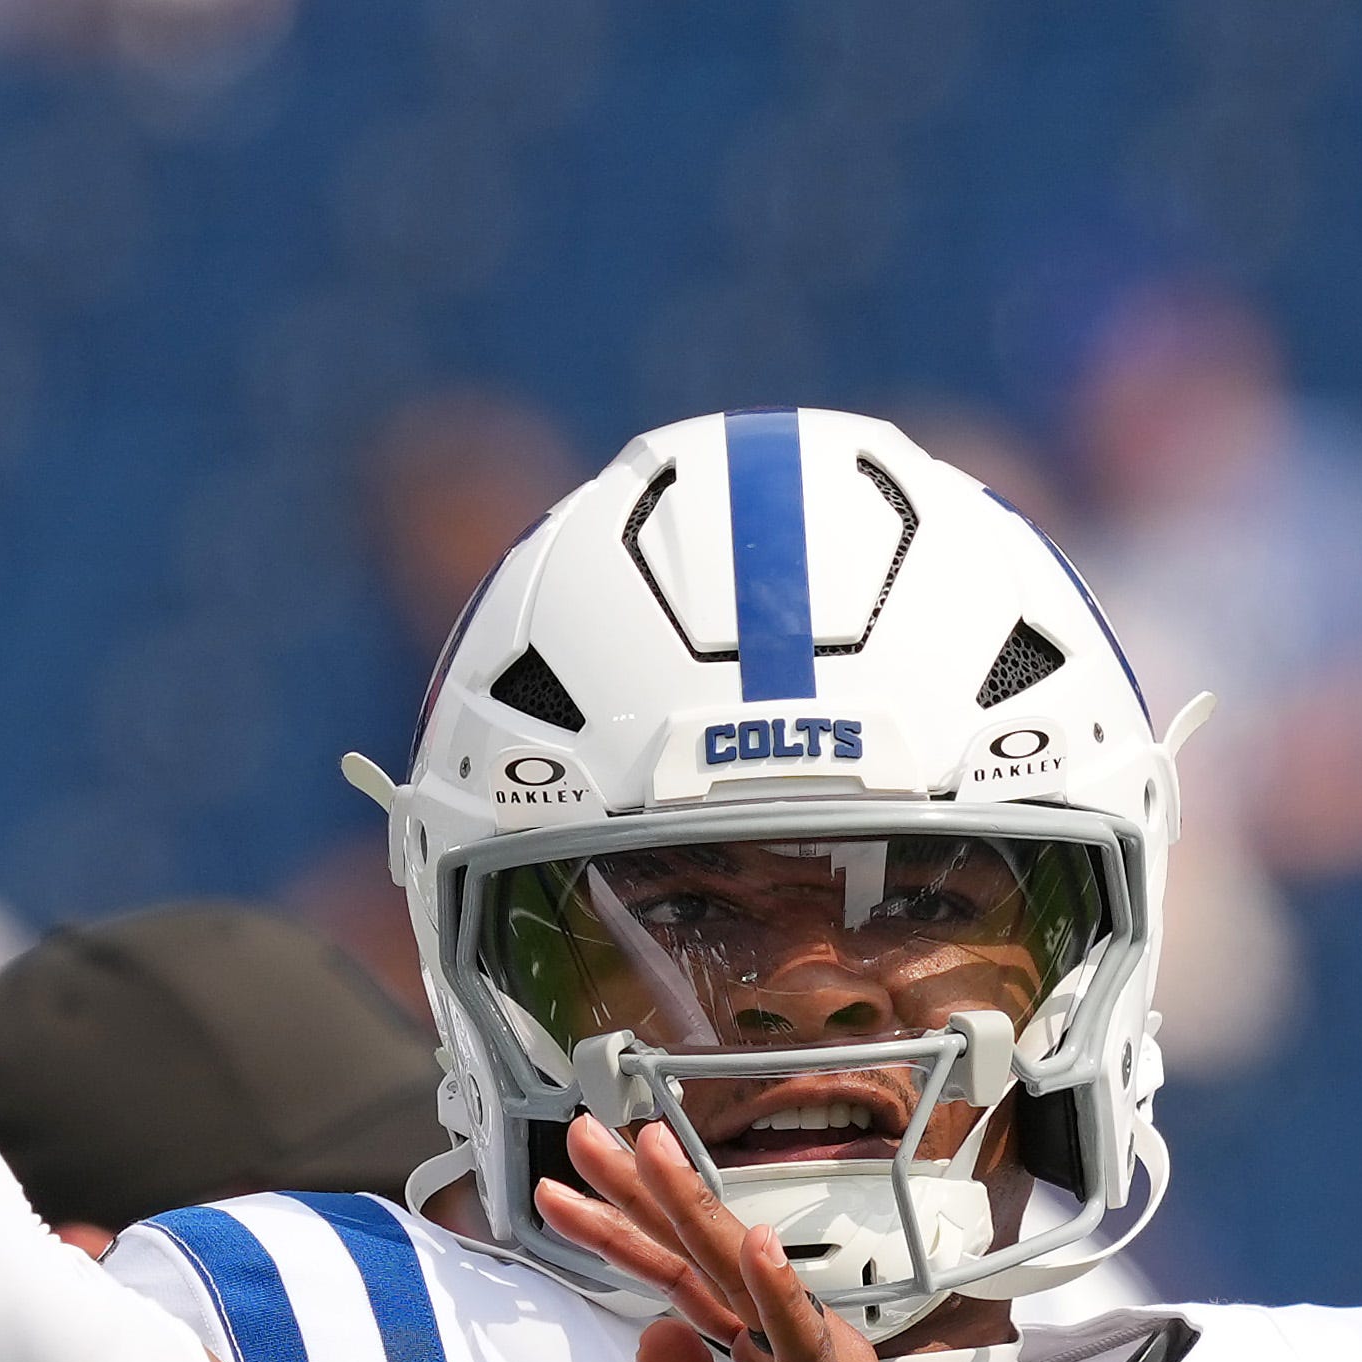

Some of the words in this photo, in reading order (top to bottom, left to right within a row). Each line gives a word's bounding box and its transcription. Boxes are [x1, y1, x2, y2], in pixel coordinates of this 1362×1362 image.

[705, 717, 863, 765] COLTS
[973, 756, 1063, 782] OAKLEY
[495, 789, 585, 804] OAKLEY
